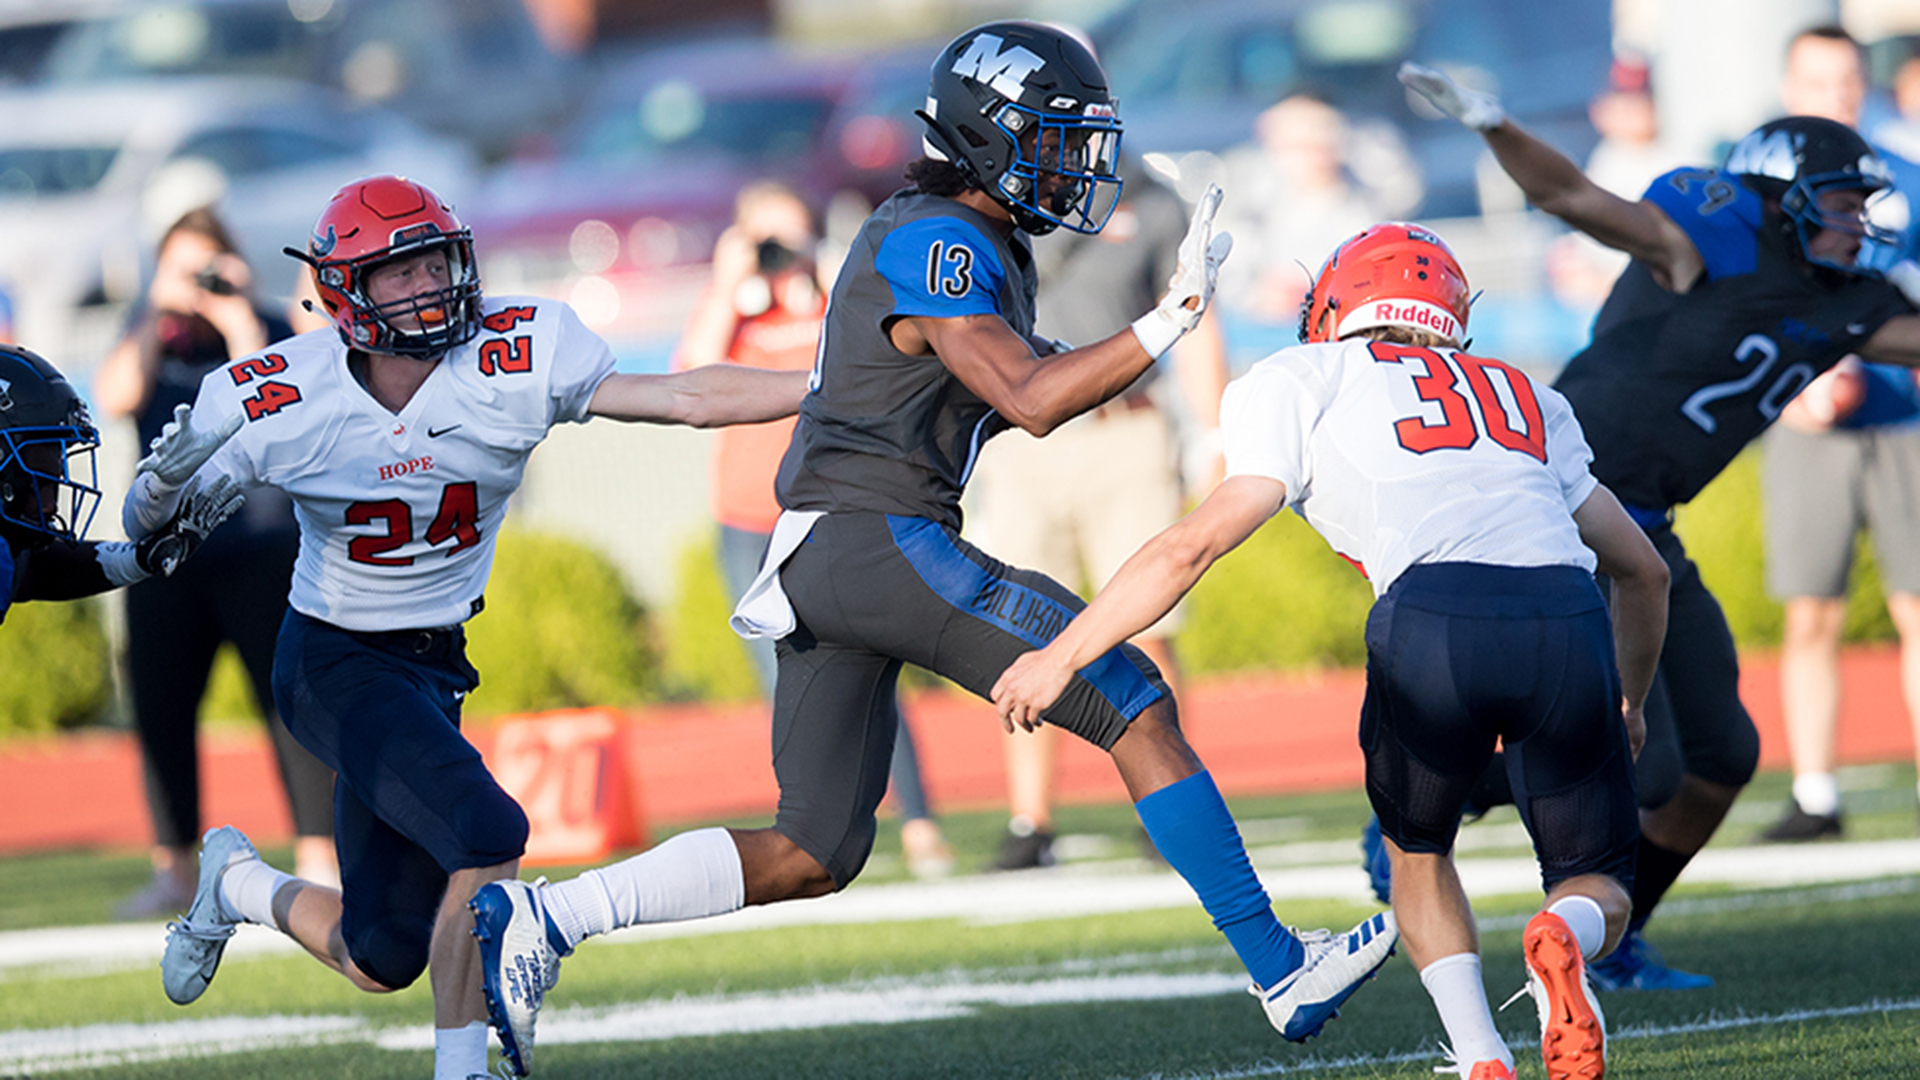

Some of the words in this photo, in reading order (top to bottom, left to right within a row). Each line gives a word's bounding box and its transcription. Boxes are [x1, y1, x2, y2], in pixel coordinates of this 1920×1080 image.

[951, 32, 1047, 102] M
[926, 239, 974, 299] 13
[478, 306, 538, 377] 24
[1375, 303, 1455, 337] Riddell
[228, 353, 303, 422] 24
[1367, 340, 1548, 465] 30
[378, 456, 435, 481] HOPE
[345, 481, 483, 566] 24
[970, 580, 1075, 642] MILLIKIN
